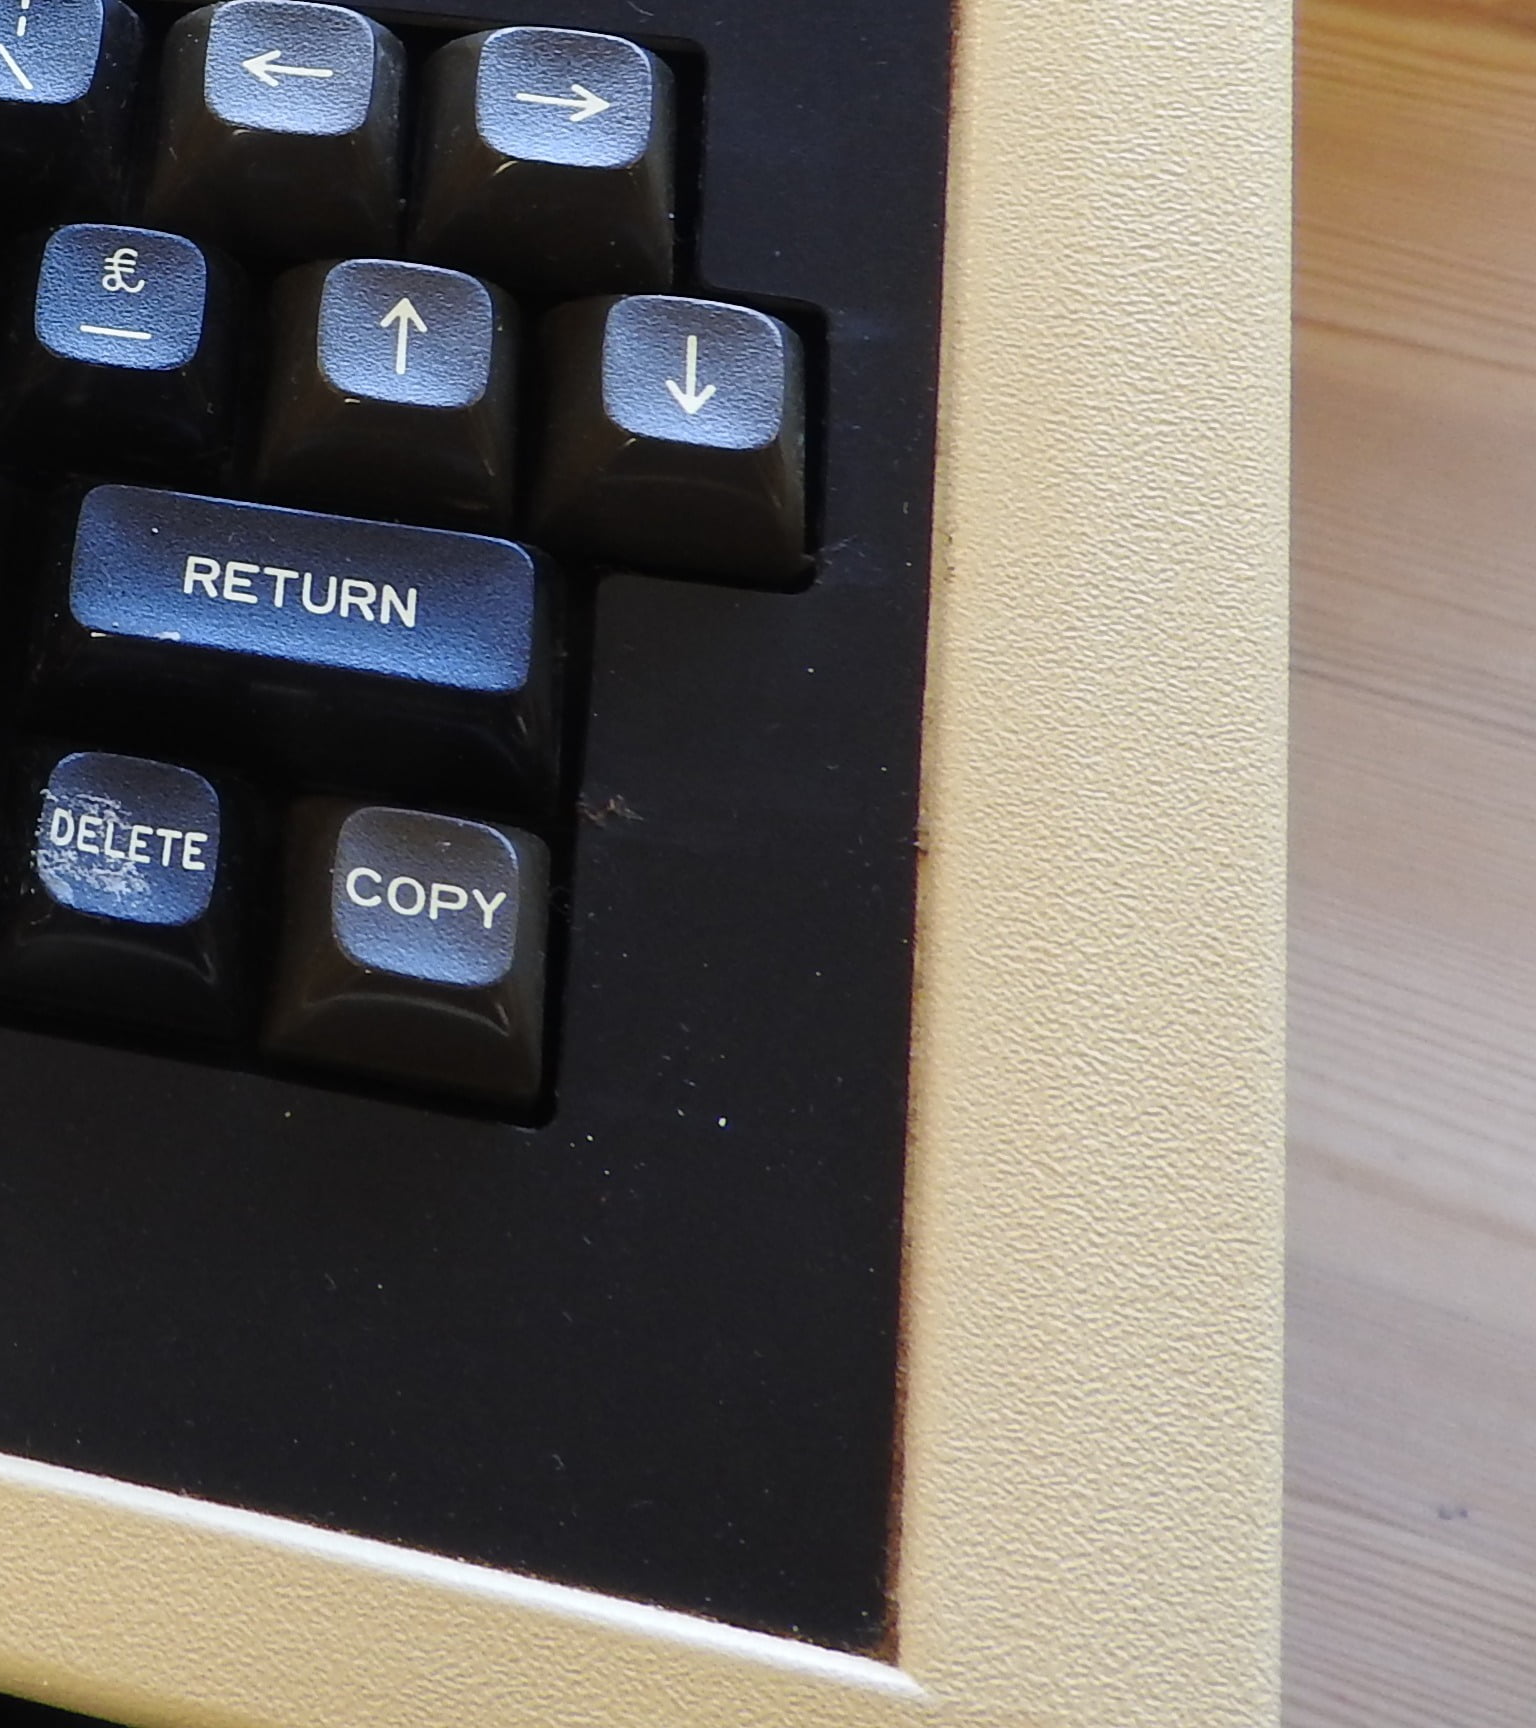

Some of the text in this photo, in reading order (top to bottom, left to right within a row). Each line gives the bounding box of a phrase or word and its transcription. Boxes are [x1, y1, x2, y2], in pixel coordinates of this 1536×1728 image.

[102, 248, 145, 293] £
[183, 556, 419, 628] RETURN
[50, 808, 208, 871] DELETE
[346, 868, 506, 928] COPY
